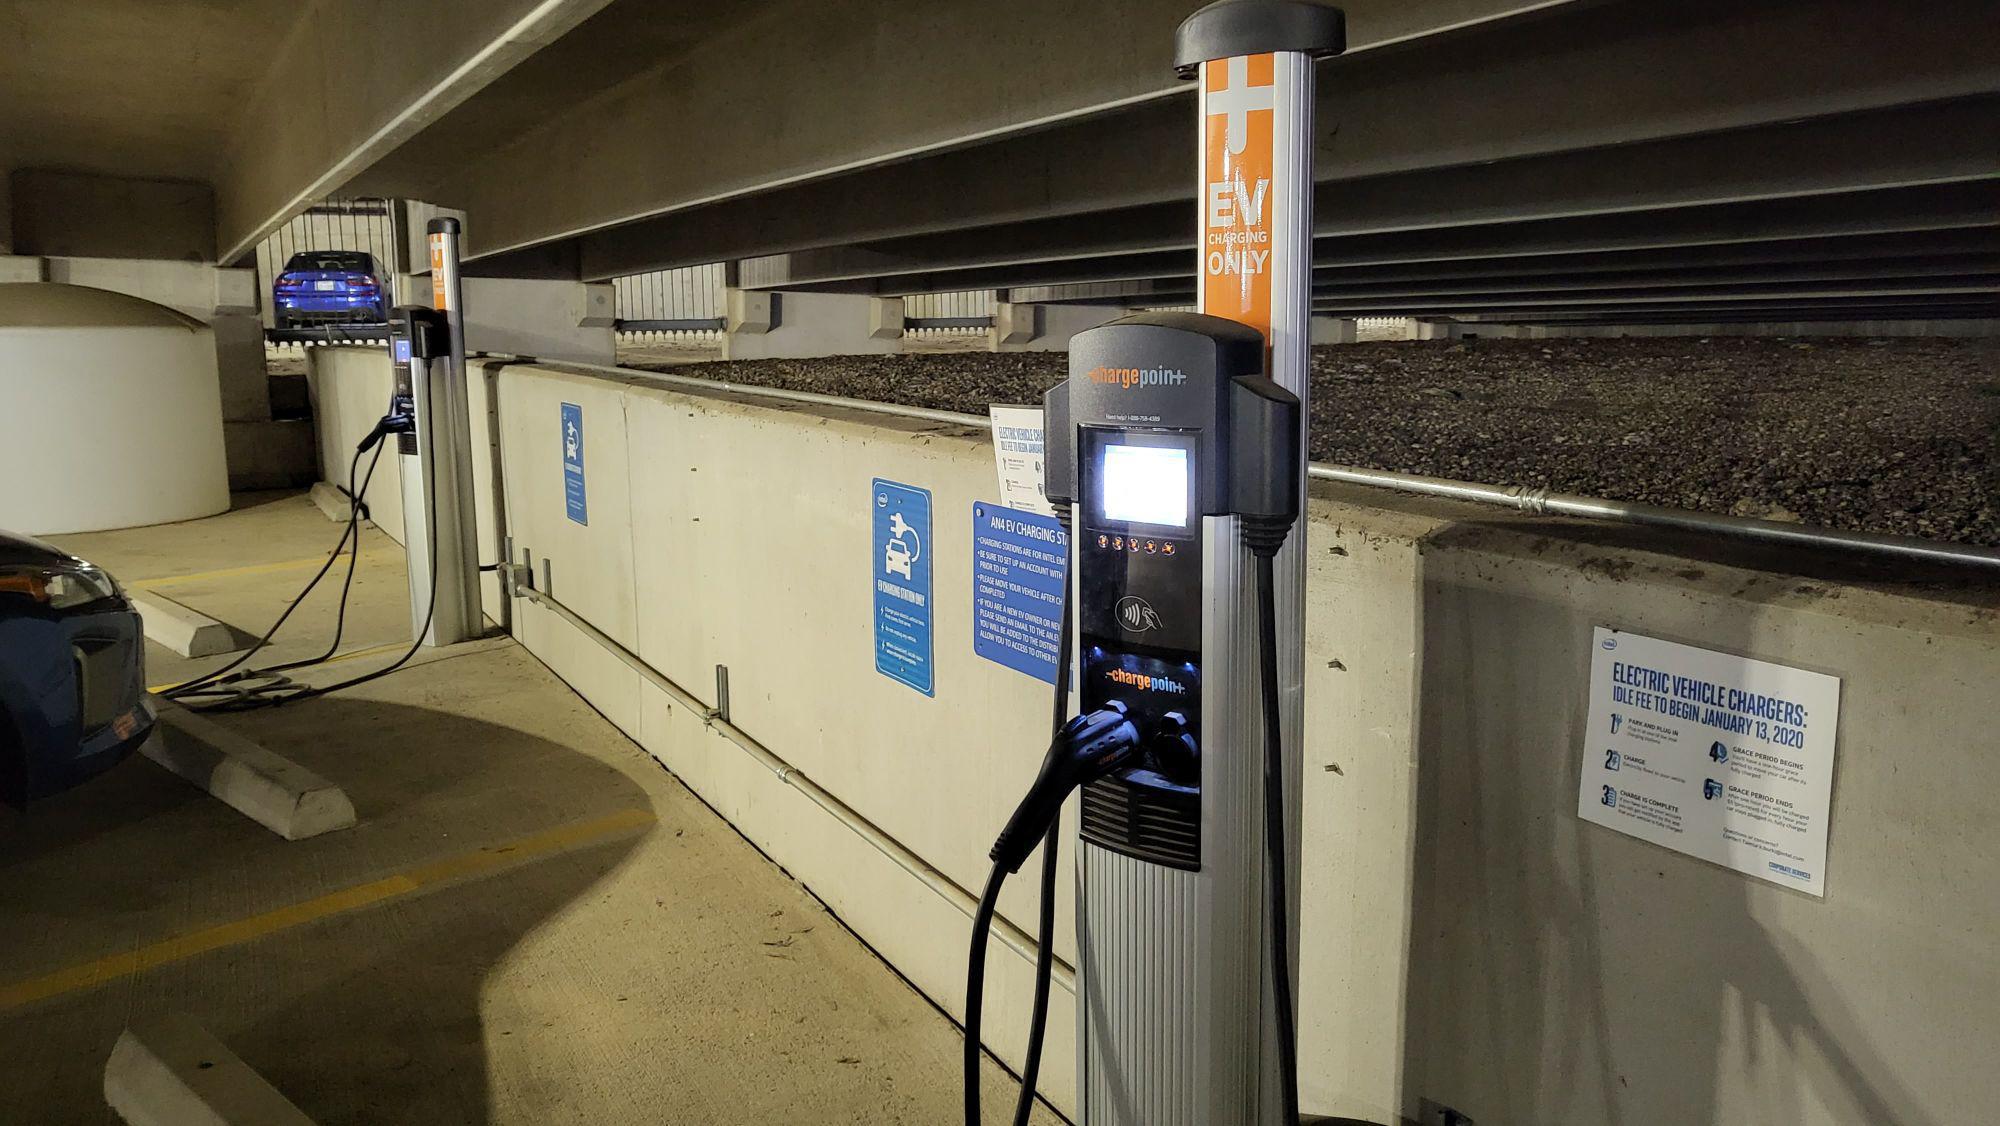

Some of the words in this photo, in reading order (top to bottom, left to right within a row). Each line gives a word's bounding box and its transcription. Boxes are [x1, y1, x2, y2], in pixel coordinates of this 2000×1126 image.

[1208, 178, 1270, 229] EV
[1208, 231, 1268, 246] CHARGING
[1208, 249, 1270, 276] ONLY
[991, 516, 1005, 530] AN4
[1006, 520, 1016, 533] EV
[1017, 522, 1055, 543] CHARGING
[980, 537, 1001, 548] CHARGING
[1002, 542, 1022, 554] STATIONS
[1023, 548, 1031, 557] ARE
[1032, 550, 1041, 559] FOR
[1042, 552, 1055, 563] INTEL
[980, 550, 985, 558] BE
[986, 552, 997, 562] SURE
[998, 554, 1003, 563] TO
[1004, 556, 1012, 565] SET
[1012, 558, 1018, 567] UP
[1019, 561, 1026, 569] AN
[1026, 562, 1049, 576] ACCOUNT
[1049, 569, 1062, 579] WITH
[980, 561, 993, 570] PRIOR
[994, 564, 999, 572] TO
[1000, 567, 1008, 575] USE
[980, 574, 994, 585] PLEASE
[995, 579, 1008, 589] MOVE
[1009, 583, 1021, 593] YOUR
[1022, 586, 1040, 599] VEHICLE
[1040, 592, 1055, 604] AFTER
[980, 585, 1005, 599] COMPLETED
[980, 608, 995, 620] PLEASE
[995, 614, 1007, 624] SEND
[1007, 618, 1014, 626] AN
[1015, 620, 1028, 631] EMAIL
[1029, 624, 1035, 633] TO
[1036, 628, 1046, 637] THE
[984, 600, 993, 608] YOU
[994, 602, 1002, 612] ARE
[1007, 606, 1018, 616] NEW
[1019, 610, 1025, 619] EV
[1025, 612, 1042, 625] OWNER
[1043, 618, 1050, 627] OR
[980, 619, 989, 628] YOU
[990, 622, 1000, 632] WILL
[1000, 626, 1006, 634] BE
[1006, 629, 1022, 640] ADDED
[1022, 634, 1029, 642] TO
[1029, 636, 1038, 646] THE
[980, 630, 995, 642] ALLOW
[995, 635, 1004, 644] YOU
[1005, 638, 1012, 647] TO
[1012, 641, 1028, 653] ACCESS
[1029, 646, 1035, 656] TO
[1036, 649, 1051, 662] OTHER
[1613, 662, 1670, 694] ELECTRIC
[1673, 675, 1726, 708] VEHICLE
[1729, 689, 1808, 728] CHARGERS:
[1613, 685, 1634, 705] IDLE
[1635, 690, 1652, 710] FEE
[1654, 695, 1667, 714] TO
[1670, 699, 1699, 722] BEGIN
[1701, 708, 1753, 735] JANUARY
[1755, 721, 1770, 744] 13,
[1773, 725, 1804, 749] 2020
[1628, 718, 1643, 726] PARK
[1644, 722, 1655, 730] AND
[1657, 726, 1671, 734] PLUG
[1624, 754, 1645, 765] CHARGE
[1733, 746, 1753, 757] GRACE
[1755, 752, 1778, 763] PERIOD
[1780, 759, 1804, 770] BEGINS
[1620, 790, 1641, 801] CHARGE
[1649, 799, 1678, 813] COMPLETE
[1729, 785, 1749, 796] GRACE
[1751, 792, 1774, 803] PERIOD
[1776, 798, 1793, 809] ENDS
